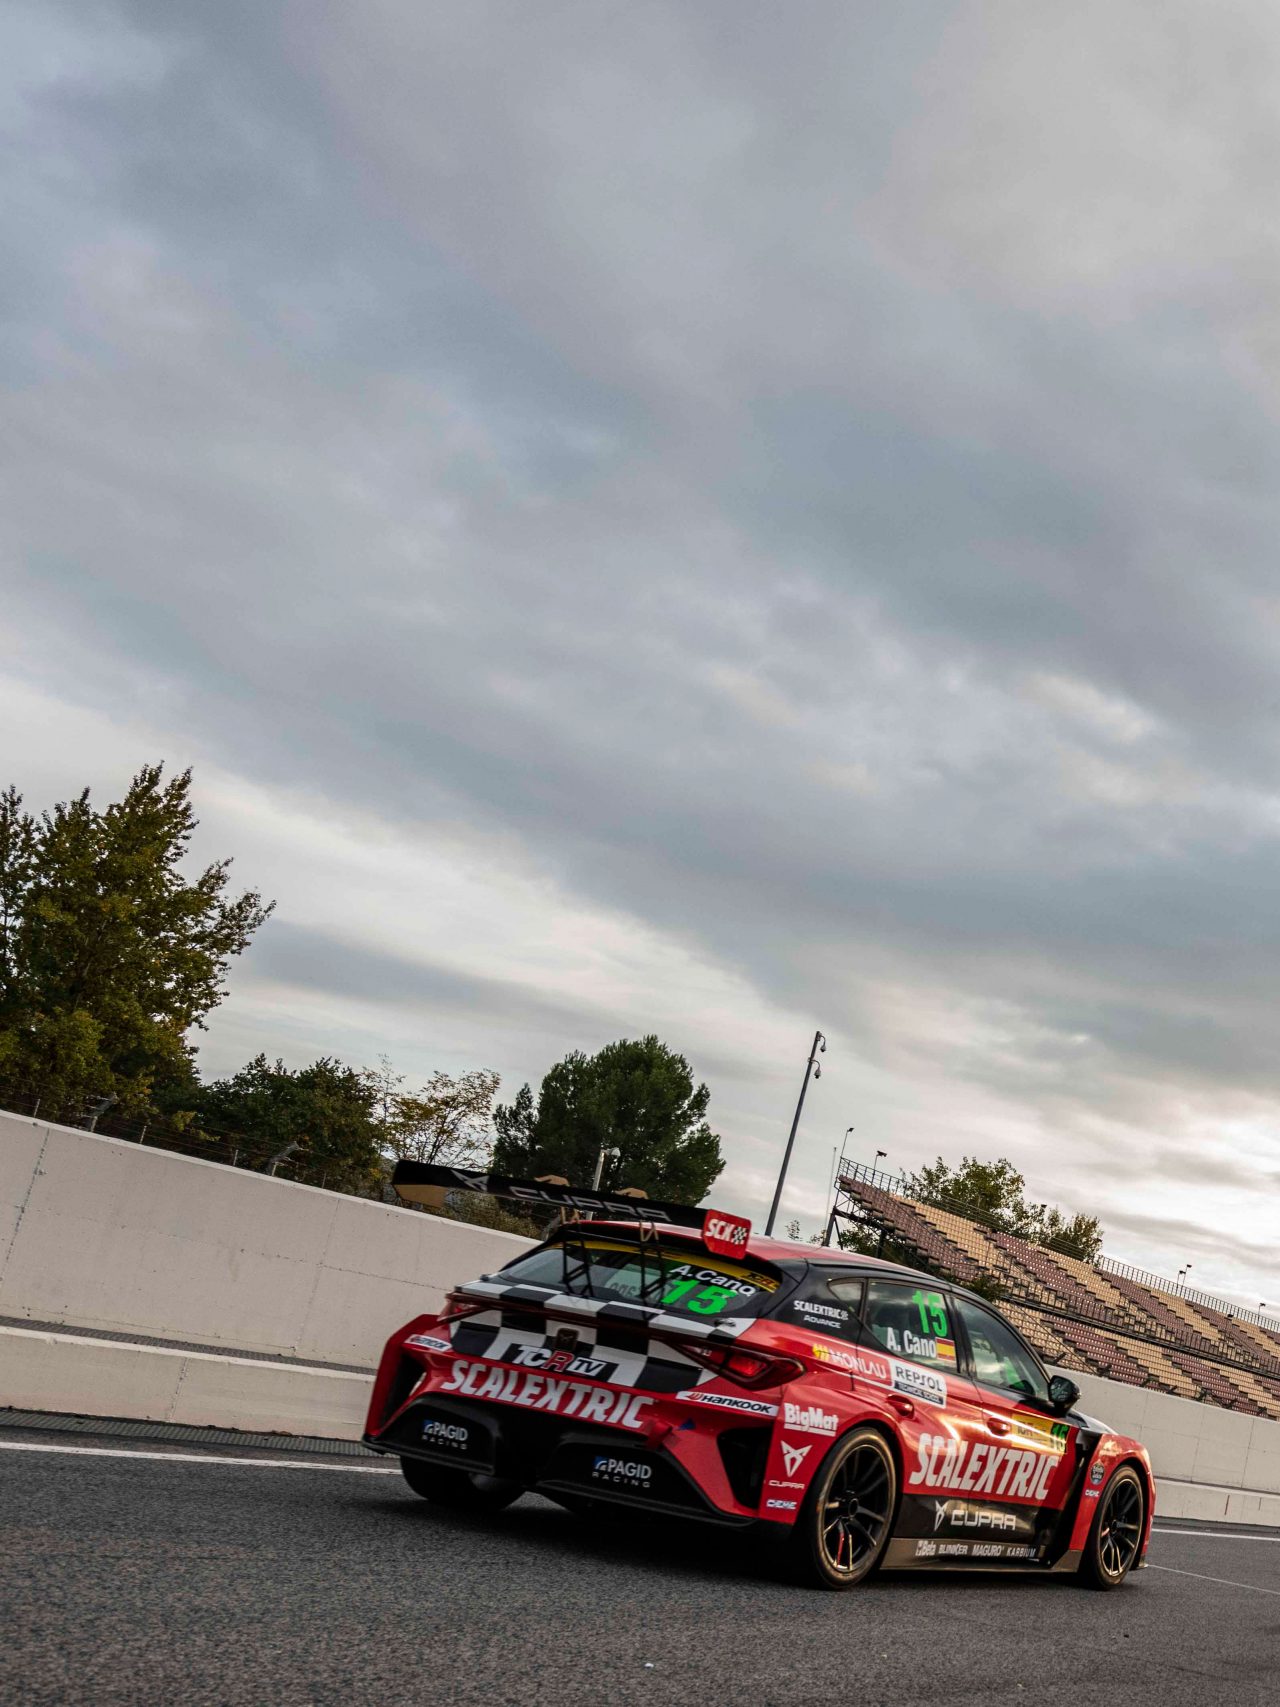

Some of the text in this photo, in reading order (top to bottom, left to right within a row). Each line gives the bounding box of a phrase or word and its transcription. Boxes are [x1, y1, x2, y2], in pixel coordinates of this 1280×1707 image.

[509, 1186, 671, 1222] CUPRA
[705, 1218, 736, 1242] SCX
[661, 1279, 738, 1315] 15
[794, 1300, 841, 1320] SCALEXTRIC
[804, 1315, 841, 1329] ADVANCE
[912, 1290, 948, 1337] 15
[886, 1327, 936, 1358] A. Cano
[513, 1345, 574, 1373] TCR
[830, 1349, 887, 1379] MONLAU
[895, 1366, 943, 1392] REPSOL
[440, 1360, 654, 1429] SCALEXTRIC
[784, 1402, 839, 1431] BigMat
[434, 1422, 469, 1442] PAGID
[592, 1471, 652, 1488] RACING
[608, 1458, 652, 1480] PAGID
[909, 1432, 1061, 1500] SCALEXTRIC
[768, 1479, 805, 1490] CUPRA
[950, 1509, 1017, 1531] CUPRA
